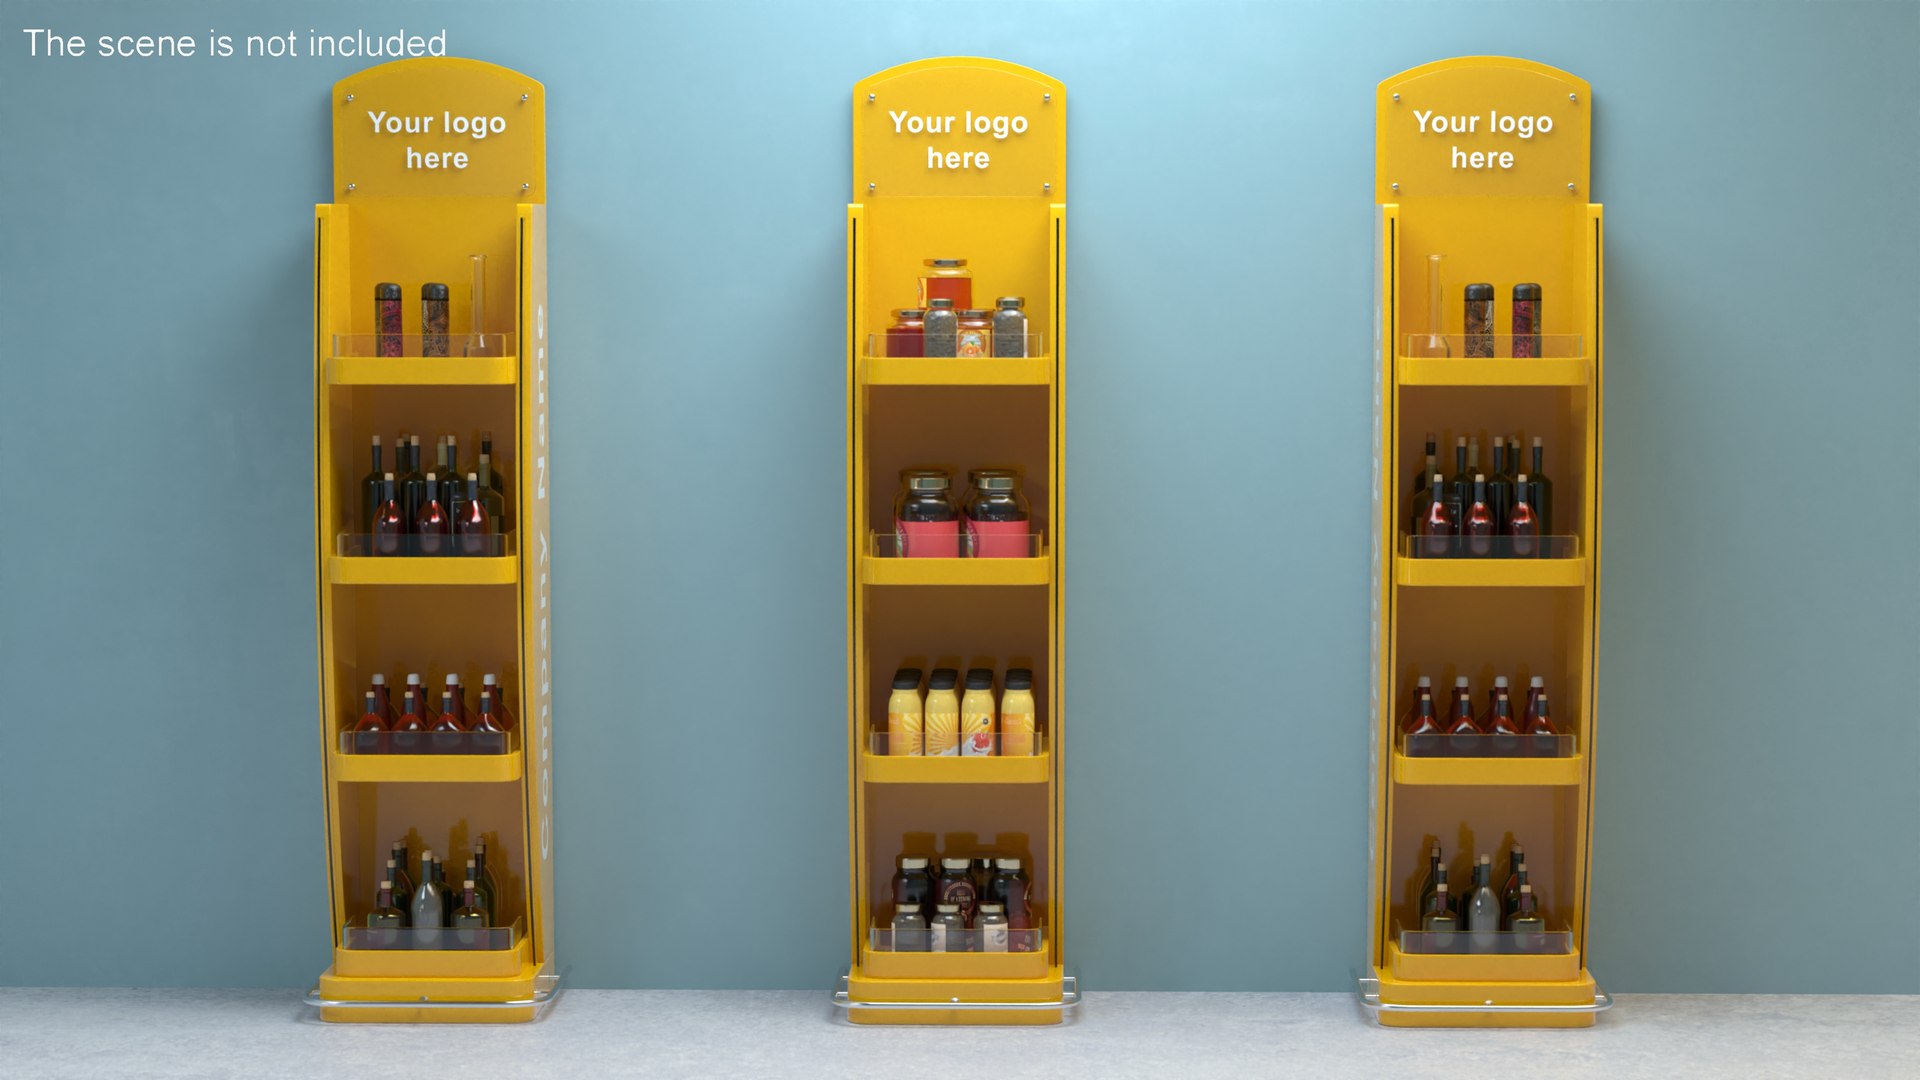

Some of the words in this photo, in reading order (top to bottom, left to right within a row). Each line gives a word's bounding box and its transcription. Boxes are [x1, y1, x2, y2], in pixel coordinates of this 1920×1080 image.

[367, 111, 434, 134] Your
[444, 111, 506, 139] logo
[889, 110, 956, 134] Your
[965, 110, 1028, 139] logo
[1413, 110, 1481, 134] Your
[1490, 110, 1553, 139] logo
[407, 146, 469, 169] here
[927, 146, 990, 169] here
[1451, 146, 1514, 169] here
[540, 531, 549, 861] Company
